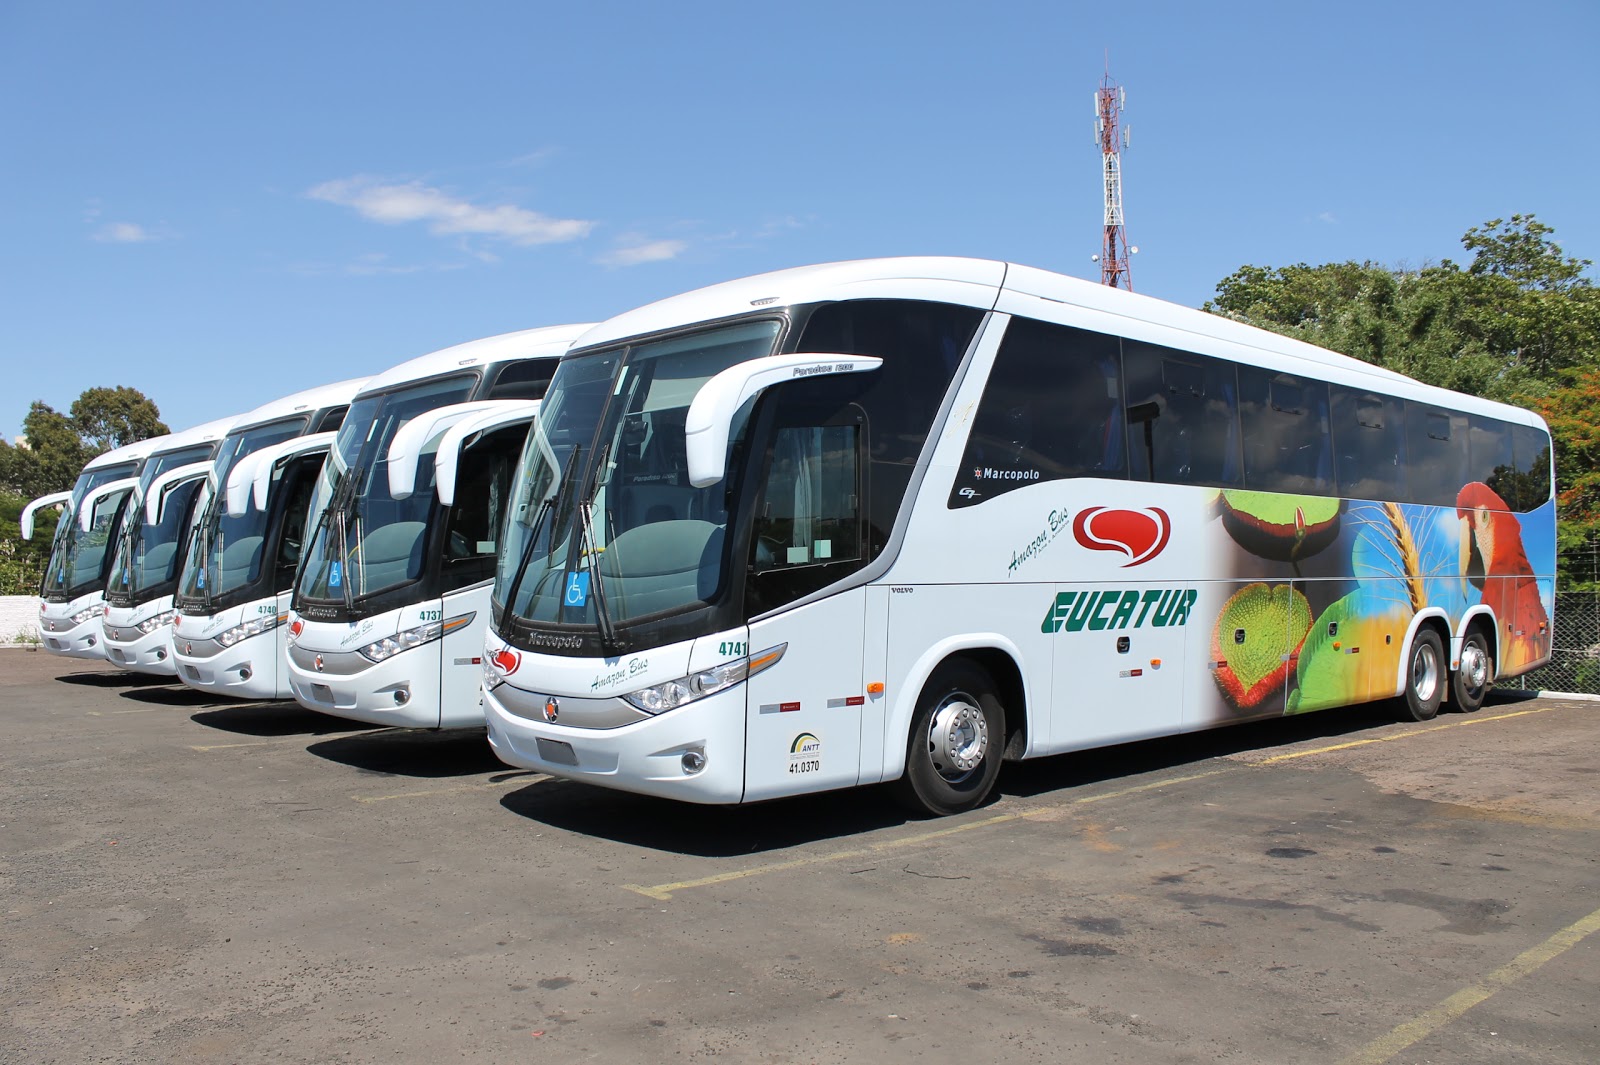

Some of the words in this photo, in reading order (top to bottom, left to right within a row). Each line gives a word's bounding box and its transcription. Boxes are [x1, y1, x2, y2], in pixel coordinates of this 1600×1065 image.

[793, 364, 833, 377] Paradiso
[983, 467, 1040, 481] Marcopolo
[1008, 530, 1047, 578] Amazon
[1047, 507, 1068, 532] Bus
[258, 605, 277, 614] 4740
[419, 610, 442, 621] 4737
[1041, 589, 1198, 634] EUCATUR
[719, 641, 747, 656] 4741
[590, 669, 626, 693] Amazon
[628, 657, 649, 674] Bus
[802, 743, 820, 752] ANTT
[789, 760, 820, 774] 41.0370
